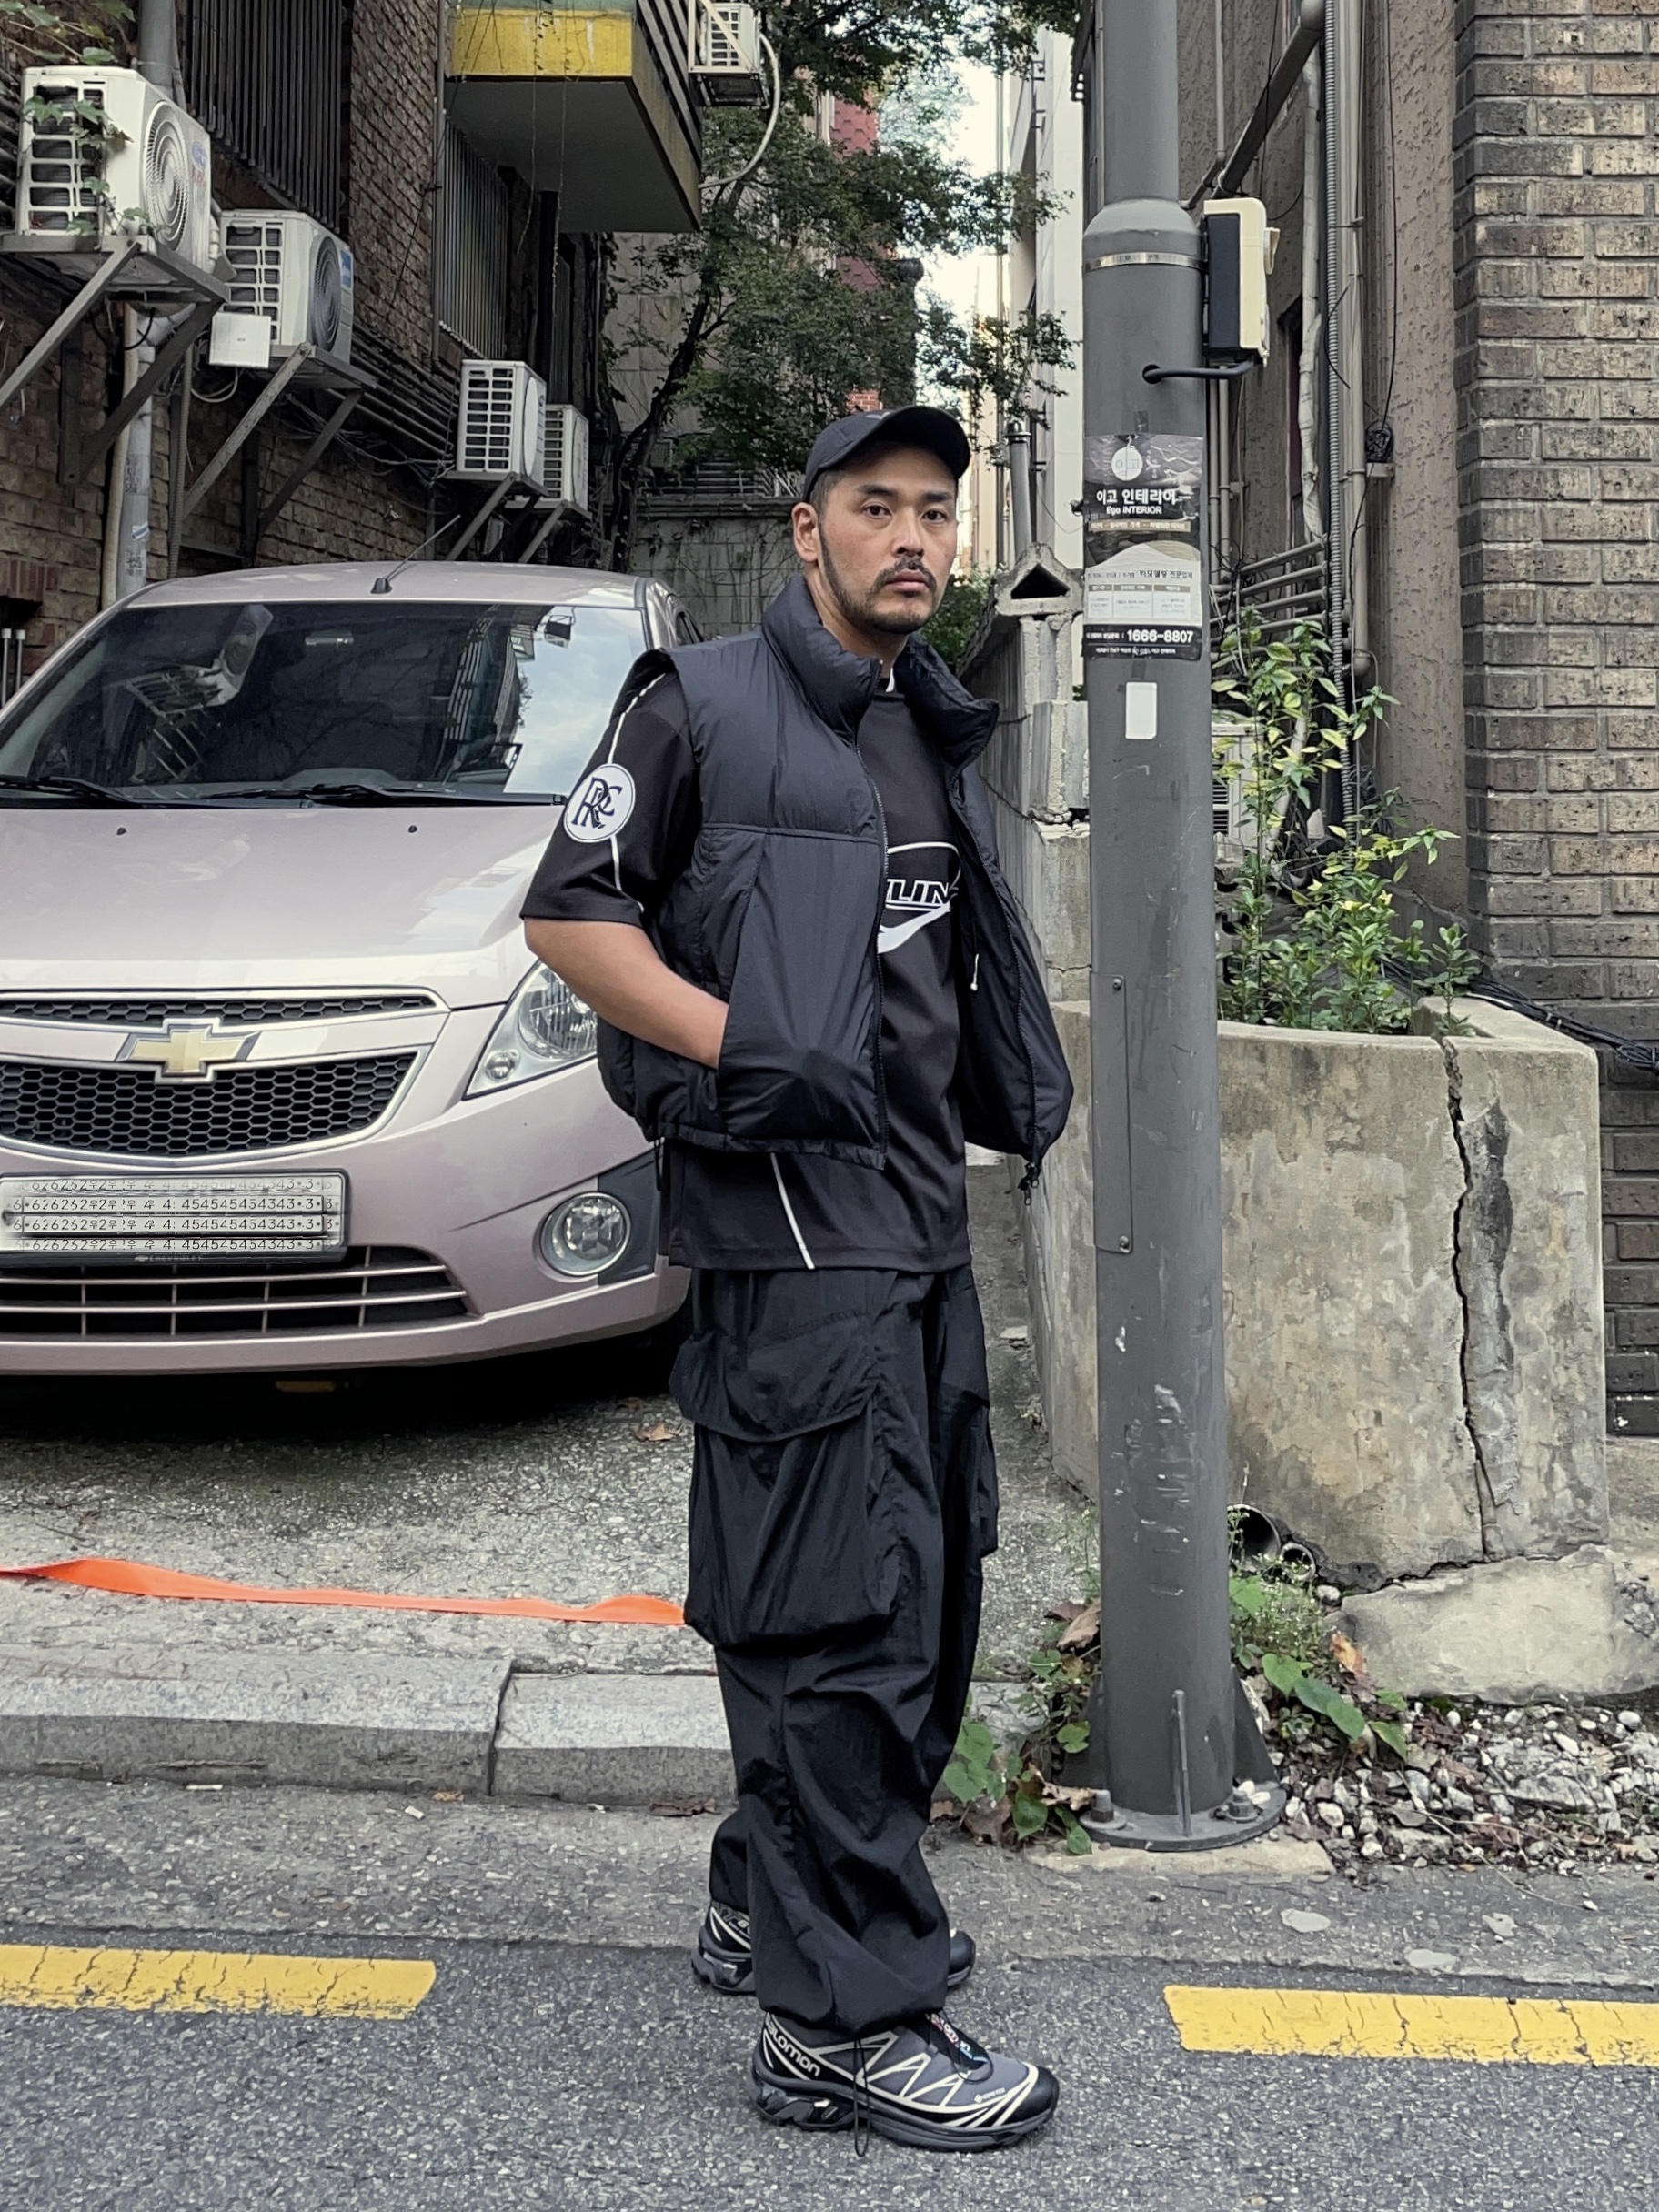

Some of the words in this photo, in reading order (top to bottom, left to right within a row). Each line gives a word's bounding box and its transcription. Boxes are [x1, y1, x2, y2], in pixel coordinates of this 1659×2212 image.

[1096, 489, 1118, 505] 이고
[1121, 488, 1177, 505] 인테리어
[1106, 506, 1121, 516] Ego
[1122, 506, 1162, 514] INTERIOR
[1127, 629, 1193, 643] 1666-8807
